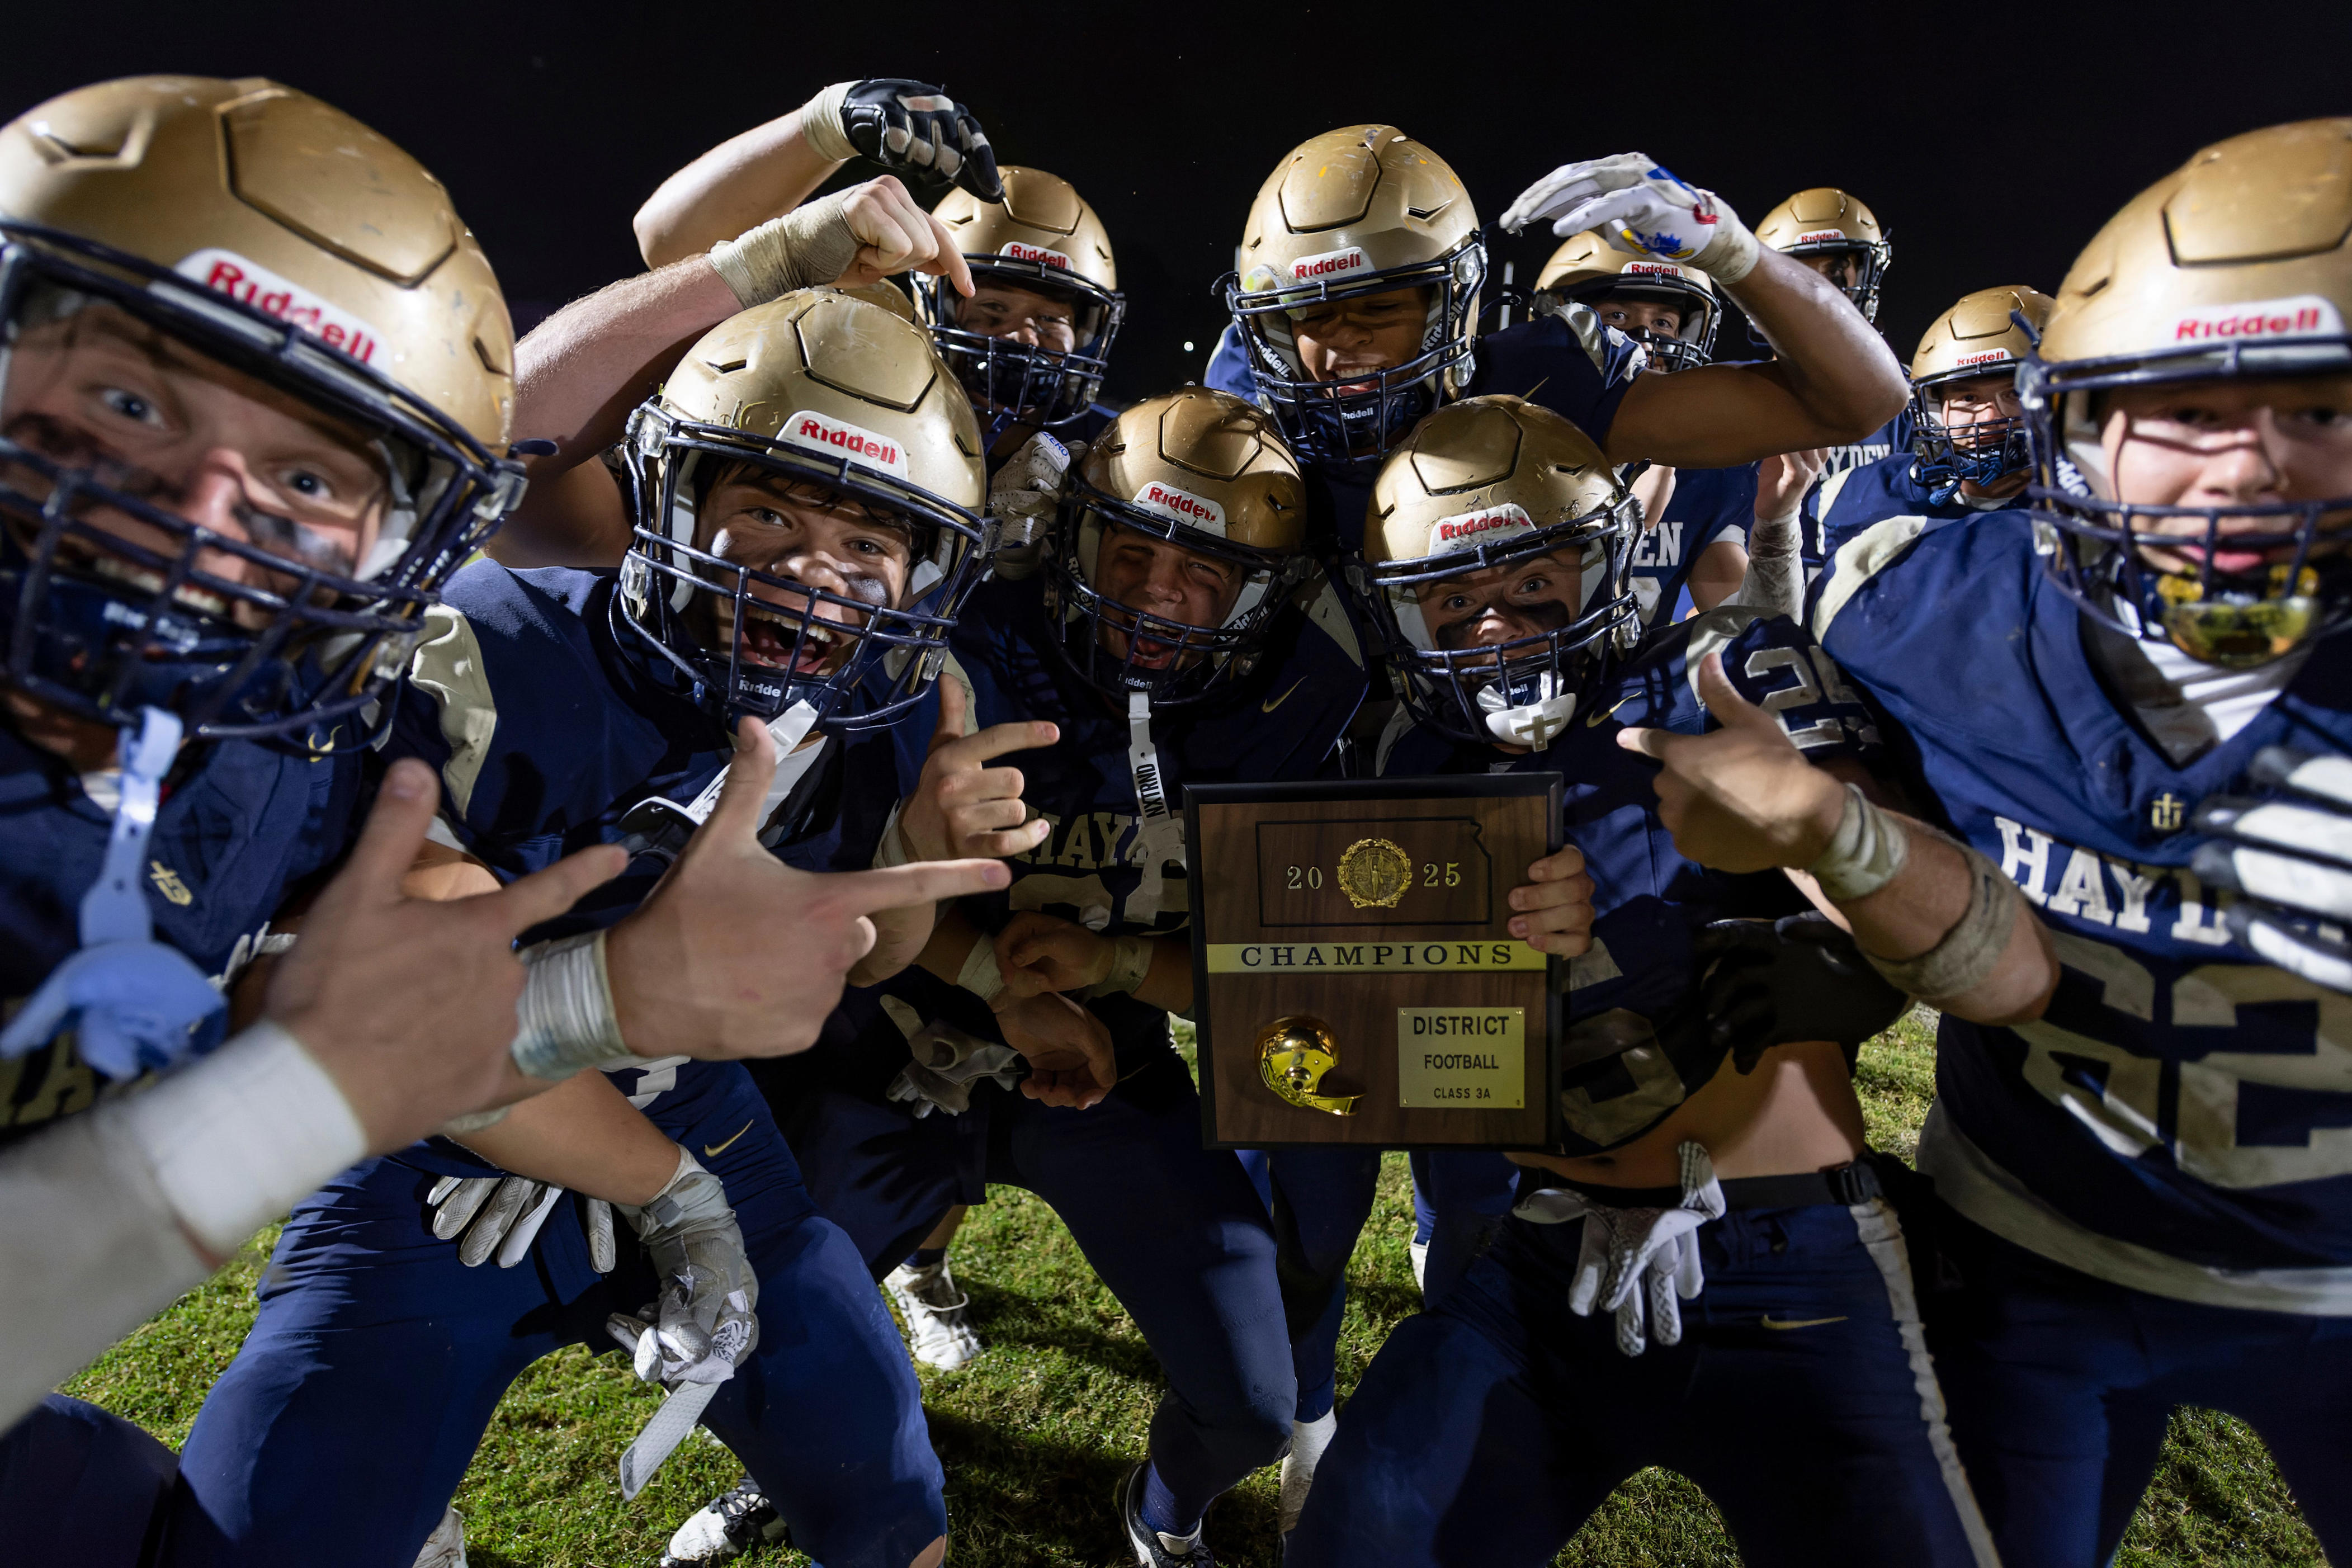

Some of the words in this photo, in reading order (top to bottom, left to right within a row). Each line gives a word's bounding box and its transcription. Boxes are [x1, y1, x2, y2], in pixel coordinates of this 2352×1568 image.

[1801, 232, 1839, 243] Riddell
[1011, 245, 1066, 268] Riddell
[1295, 253, 1361, 278] Riddell
[1631, 264, 1678, 276] Riddell
[206, 259, 376, 364] Riddell
[2176, 308, 2319, 341] Riddell
[1957, 351, 2004, 366] Riddell
[800, 419, 897, 465] Riddell
[738, 679, 791, 700] Riddel
[1136, 762, 1166, 818] NXTRND
[1287, 866, 1323, 890] 20
[1423, 862, 1461, 888] 25
[1241, 944, 1512, 966] CHAMPIONS
[1413, 1016, 1509, 1035] DISTRICT
[1424, 1054, 1499, 1069] FOOTBALL
[1434, 1088, 1470, 1099] CLASS
[1476, 1088, 1491, 1099] 3A
